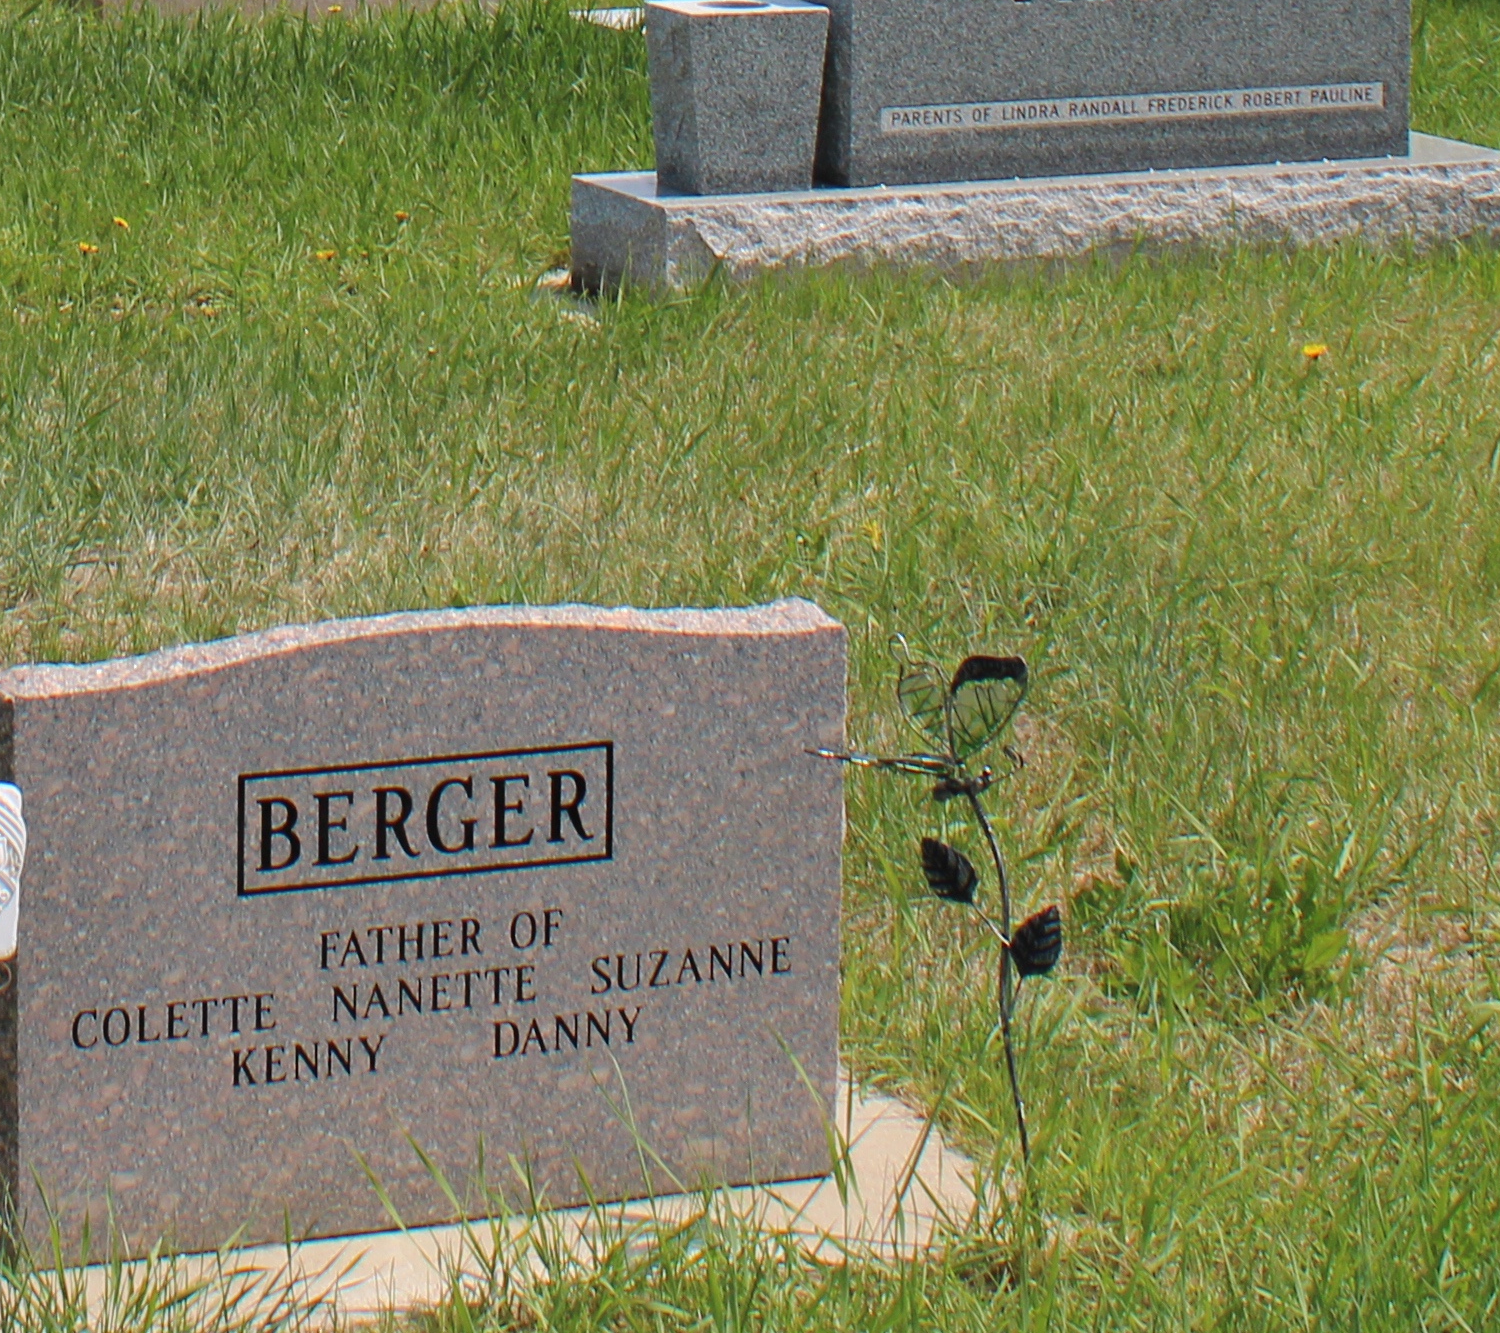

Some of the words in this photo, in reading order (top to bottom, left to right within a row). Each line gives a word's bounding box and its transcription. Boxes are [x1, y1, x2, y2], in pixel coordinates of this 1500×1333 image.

[890, 107, 963, 126] PARENTS
[971, 106, 993, 123] OF
[1147, 93, 1235, 114] FREDERICK
[1309, 86, 1374, 104] PAULINE
[255, 768, 595, 873] BERGER
[318, 918, 483, 970] FATHER
[508, 907, 565, 954] OF
[71, 993, 278, 1053] COLETTE
[330, 965, 538, 1023] NANETTE
[589, 936, 793, 997] SUZANNE
[230, 1034, 387, 1087] KENNY
[491, 1005, 645, 1059] DANNY
